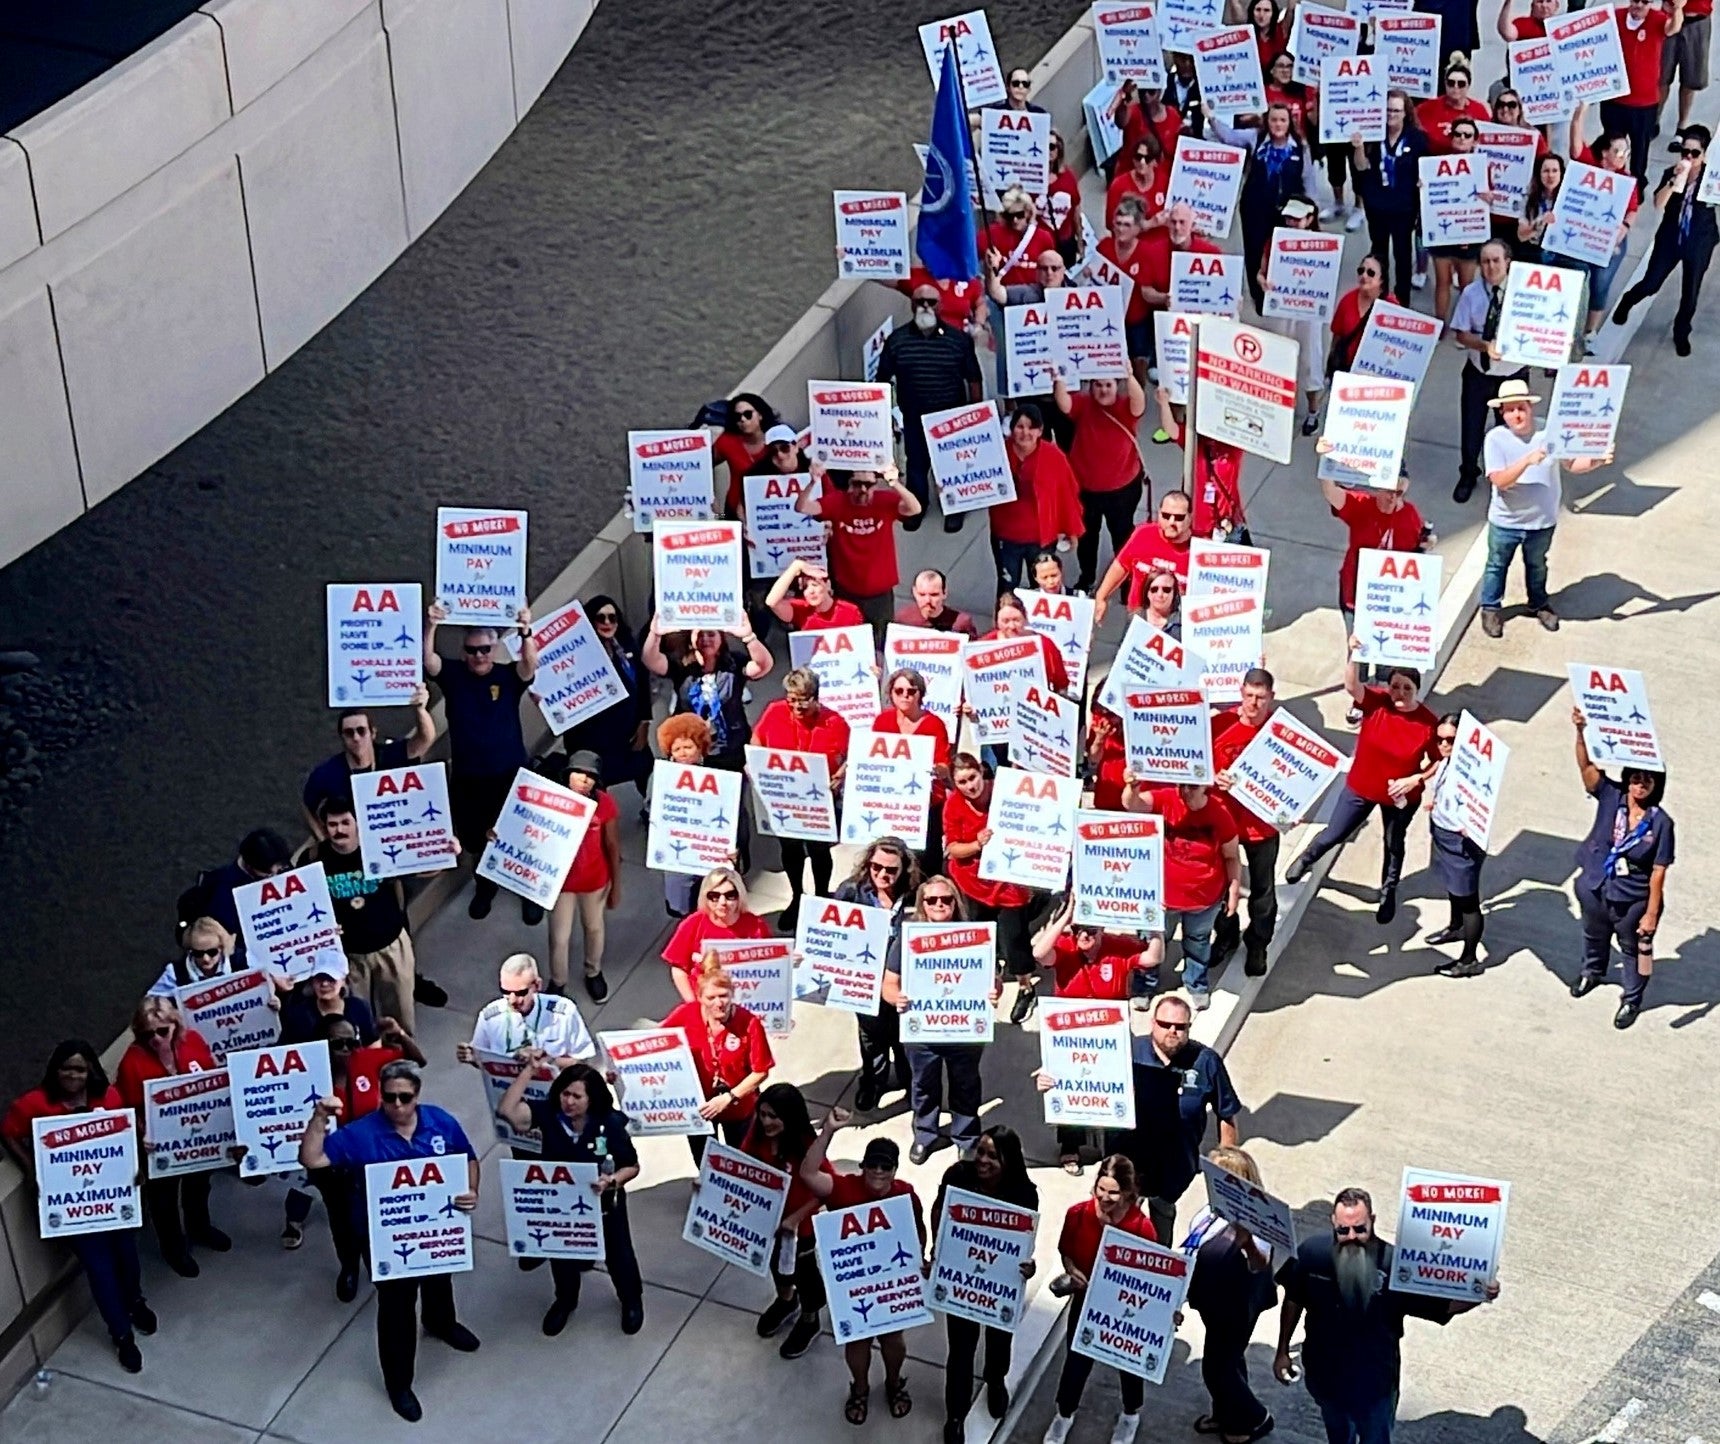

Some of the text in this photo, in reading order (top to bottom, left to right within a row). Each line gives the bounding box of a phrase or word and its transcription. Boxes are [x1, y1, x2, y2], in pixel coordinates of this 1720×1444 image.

[1574, 48, 1594, 60] PAY
[1574, 78, 1607, 92] WORK
[1436, 158, 1470, 176] AA
[1581, 170, 1613, 192] AA
[860, 228, 881, 237] PAY
[856, 258, 889, 266] WORK
[1292, 268, 1313, 277] PAY
[1526, 270, 1561, 291] AA
[1208, 356, 1284, 388] NO PARKING
[1208, 373, 1227, 386] NO
[1230, 378, 1283, 404] WAITING
[937, 432, 992, 452] MINIMUM
[955, 447, 977, 461] PAY
[956, 482, 993, 496] WORK
[448, 543, 511, 555] MINIMUM
[466, 557, 493, 569] PAY
[666, 554, 728, 564] MINIMUM
[685, 567, 709, 577] PAY
[1379, 556, 1419, 580] AA
[443, 583, 515, 596] MAXIMUM
[663, 591, 733, 602] MAXIMUM
[352, 590, 398, 612] AA
[457, 597, 499, 609] WORK
[678, 604, 717, 614] WORK
[551, 654, 575, 674] PAY
[544, 666, 608, 706] MAXIMUM
[1590, 670, 1627, 693] AA
[563, 685, 601, 710] WORK
[1136, 693, 1152, 703] NO
[1133, 712, 1196, 725] MINIMUM
[1152, 725, 1178, 735] PAY
[1131, 745, 1203, 759] MAXIMUM
[1264, 737, 1318, 781] MINIMUM
[1147, 758, 1188, 769] WORK
[1271, 758, 1295, 777] PAY
[1242, 765, 1299, 810] MAXIMUM
[1246, 783, 1279, 810] WORK
[1089, 823, 1104, 835] NO
[1084, 844, 1150, 860] MINIMUM
[1103, 860, 1130, 871] PAY
[1080, 883, 1155, 900] MAXIMUM
[1096, 899, 1138, 913] WORK
[820, 904, 865, 930] AA
[920, 935, 936, 948] NO
[915, 958, 982, 969] MINIMUM
[934, 972, 961, 983] PAY
[908, 999, 986, 1011] MAXIMUM
[925, 1014, 968, 1025] WORK
[1056, 1013, 1070, 1025] NO
[1052, 1035, 1116, 1049] MINIMUM
[1072, 1051, 1097, 1063] PAY
[640, 1075, 665, 1085] PAY
[1052, 1078, 1124, 1094] MAXIMUM
[1067, 1095, 1109, 1107] WORK
[643, 1111, 686, 1122] WORK
[54, 1129, 70, 1142] NO
[49, 1145, 123, 1164] MINIMUM
[72, 1162, 102, 1176] PAY
[717, 1157, 734, 1170] NO
[391, 1162, 444, 1189] AA
[47, 1185, 131, 1206] MAXIMUM
[708, 1172, 772, 1209] MINIMUM
[1421, 1185, 1438, 1198] NO
[723, 1192, 752, 1213] PAY
[66, 1202, 114, 1218] WORK
[961, 1207, 976, 1219] NO
[840, 1206, 891, 1240] AA
[1411, 1206, 1488, 1229] MINIMUM
[441, 1226, 464, 1236] AND
[695, 1206, 767, 1247] MAXIMUM
[1431, 1224, 1464, 1238] PAY
[708, 1225, 749, 1253] WORK
[950, 1225, 1020, 1257] MINIMUM
[430, 1248, 465, 1259] DOWN
[967, 1246, 998, 1265] PAY
[1115, 1247, 1131, 1261] NO
[1400, 1248, 1487, 1270] MAXIMUM
[896, 1274, 919, 1287] AND
[1417, 1265, 1468, 1282] WORK
[937, 1266, 1017, 1300] MAXIMUM
[1103, 1266, 1171, 1303] MINIMUM
[952, 1285, 998, 1310] WORK
[1117, 1289, 1148, 1309] PAY
[889, 1298, 924, 1313] DOWN
[1086, 1308, 1164, 1348] MAXIMUM
[1099, 1329, 1143, 1357] WORK
